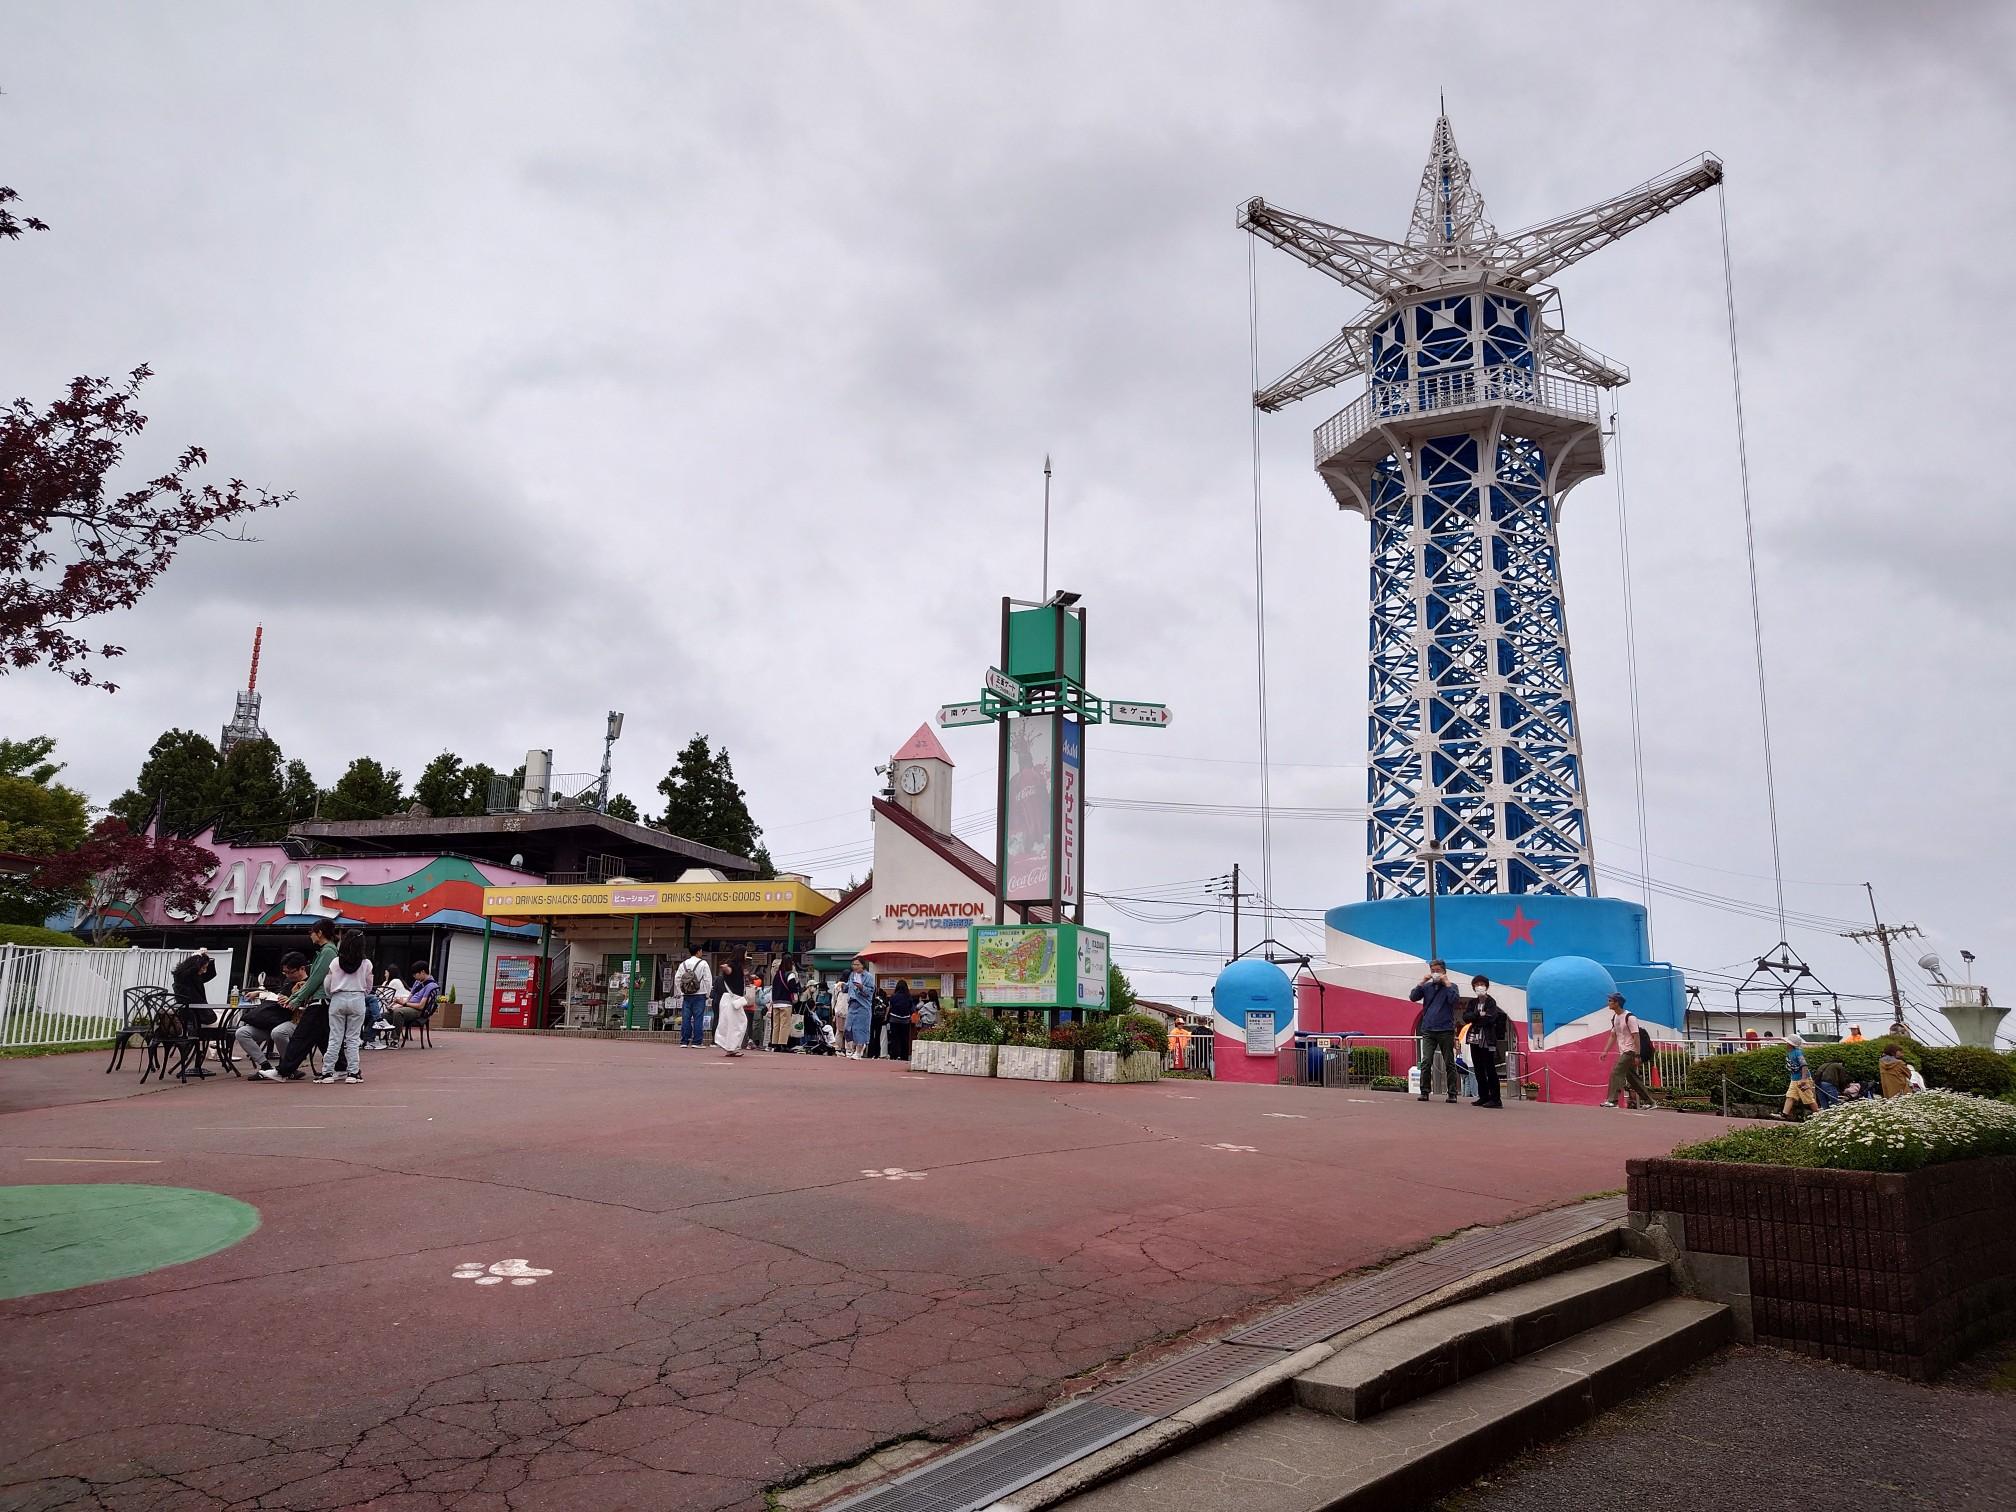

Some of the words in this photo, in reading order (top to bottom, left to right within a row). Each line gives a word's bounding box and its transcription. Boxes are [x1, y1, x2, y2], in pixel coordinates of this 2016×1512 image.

[950, 707, 977, 717] 南ゲー
[1119, 706, 1157, 717] 北ゲート
[1063, 770, 1075, 898] アサヒビール
[613, 894, 656, 904] ビューショップ
[884, 902, 984, 918] INFORMATION
